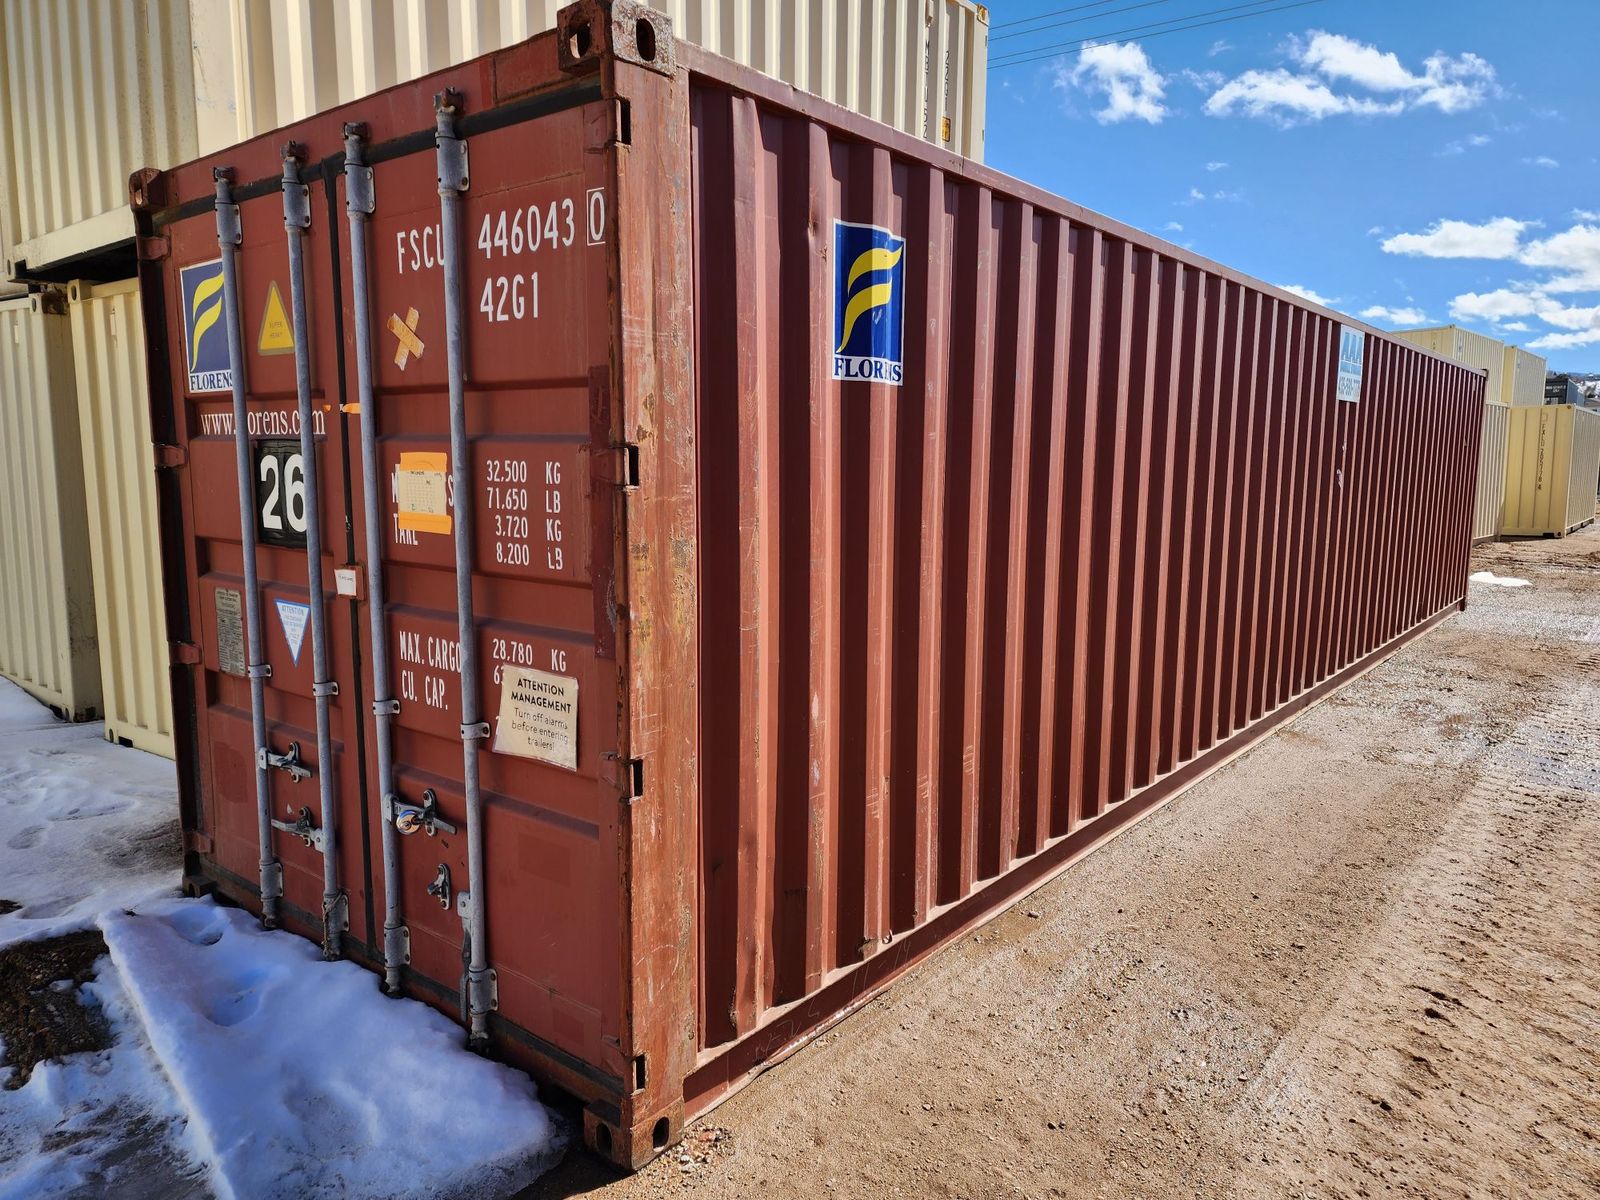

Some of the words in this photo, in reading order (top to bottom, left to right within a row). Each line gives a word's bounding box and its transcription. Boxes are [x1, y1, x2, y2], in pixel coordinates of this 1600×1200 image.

[397, 223, 446, 274] FSCU
[478, 198, 575, 259] 446043
[590, 191, 605, 241] 0
[480, 271, 538, 322] 42G1
[201, 410, 326, 435] www.orens.cm
[545, 461, 561, 485] KG
[261, 453, 307, 533] 26
[545, 490, 561, 514] LB
[546, 519, 562, 542] KG
[547, 546, 563, 570] LB
[399, 630, 425, 665] MAX.
[428, 636, 462, 673] CARGO
[551, 649, 567, 672] KG
[401, 669, 418, 702] CU.
[425, 676, 448, 710] CAP.
[517, 677, 564, 696] ATTENTION
[511, 691, 571, 714] MANAGEMENT
[514, 707, 531, 720] Turn
[533, 712, 543, 723] off
[544, 716, 568, 730] alarms
[511, 720, 538, 734] before
[539, 728, 569, 745] entering
